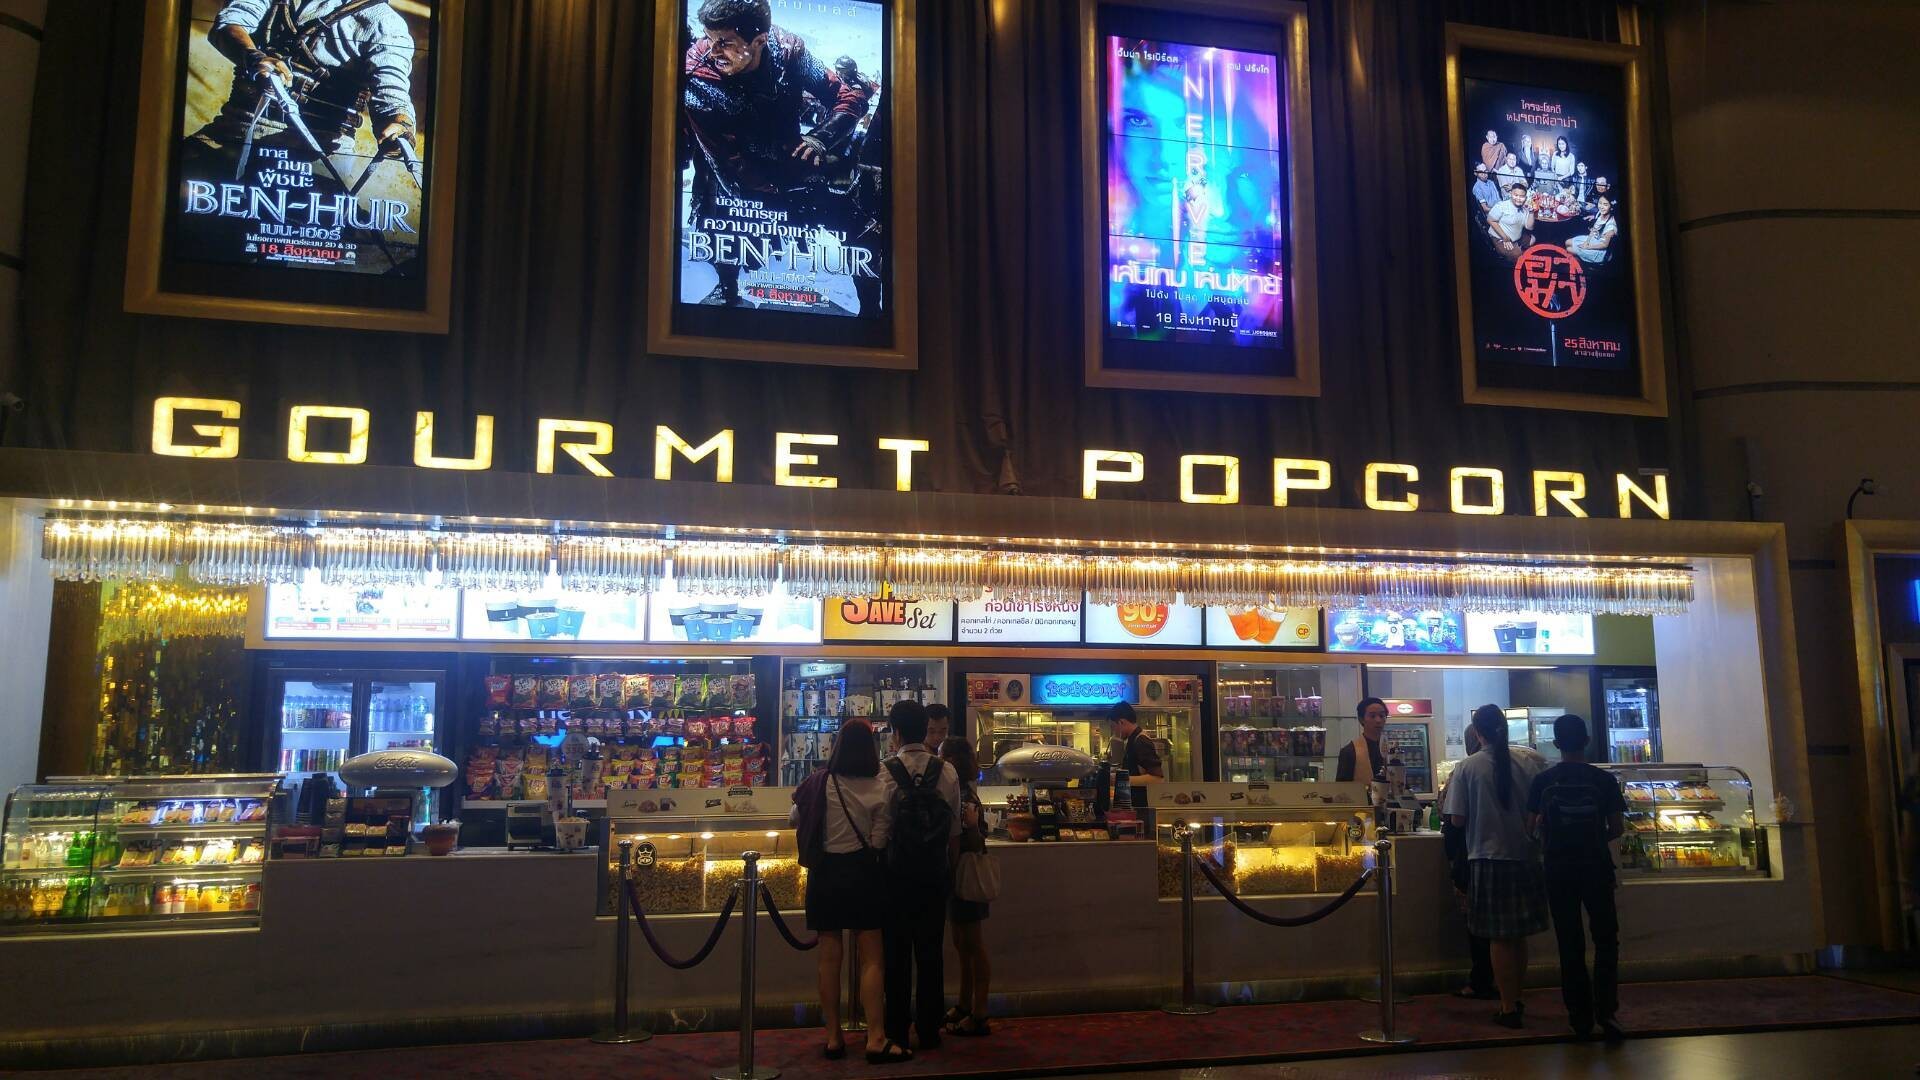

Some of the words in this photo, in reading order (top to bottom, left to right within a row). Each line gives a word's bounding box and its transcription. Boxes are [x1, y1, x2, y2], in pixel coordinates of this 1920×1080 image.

[1520, 99, 1562, 114] ใครจะโชคดี
[259, 147, 289, 159] ทาส
[277, 159, 313, 176] กบฏ
[1184, 75, 1207, 266] NERVE
[257, 168, 314, 188] ผู้ชนะ
[184, 179, 417, 235] BEN-HUR
[716, 195, 764, 209] น้องชาย
[729, 207, 788, 222] คนทรยศ
[260, 223, 342, 241] เบน-เฮอร์
[260, 243, 279, 254] 18
[284, 244, 341, 259] สิงหาคม
[687, 230, 880, 279] BEN-HUR
[748, 288, 765, 298] 18
[769, 288, 817, 303] สิงหาคม
[1156, 312, 1172, 323] 18
[1180, 312, 1240, 329] สิงหาคมนี้
[1564, 338, 1578, 348] 25
[1579, 337, 1621, 351] สิงหาคม
[151, 396, 930, 492] GOURMET
[1082, 449, 1671, 521] POPCORN
[907, 607, 937, 629] Set
